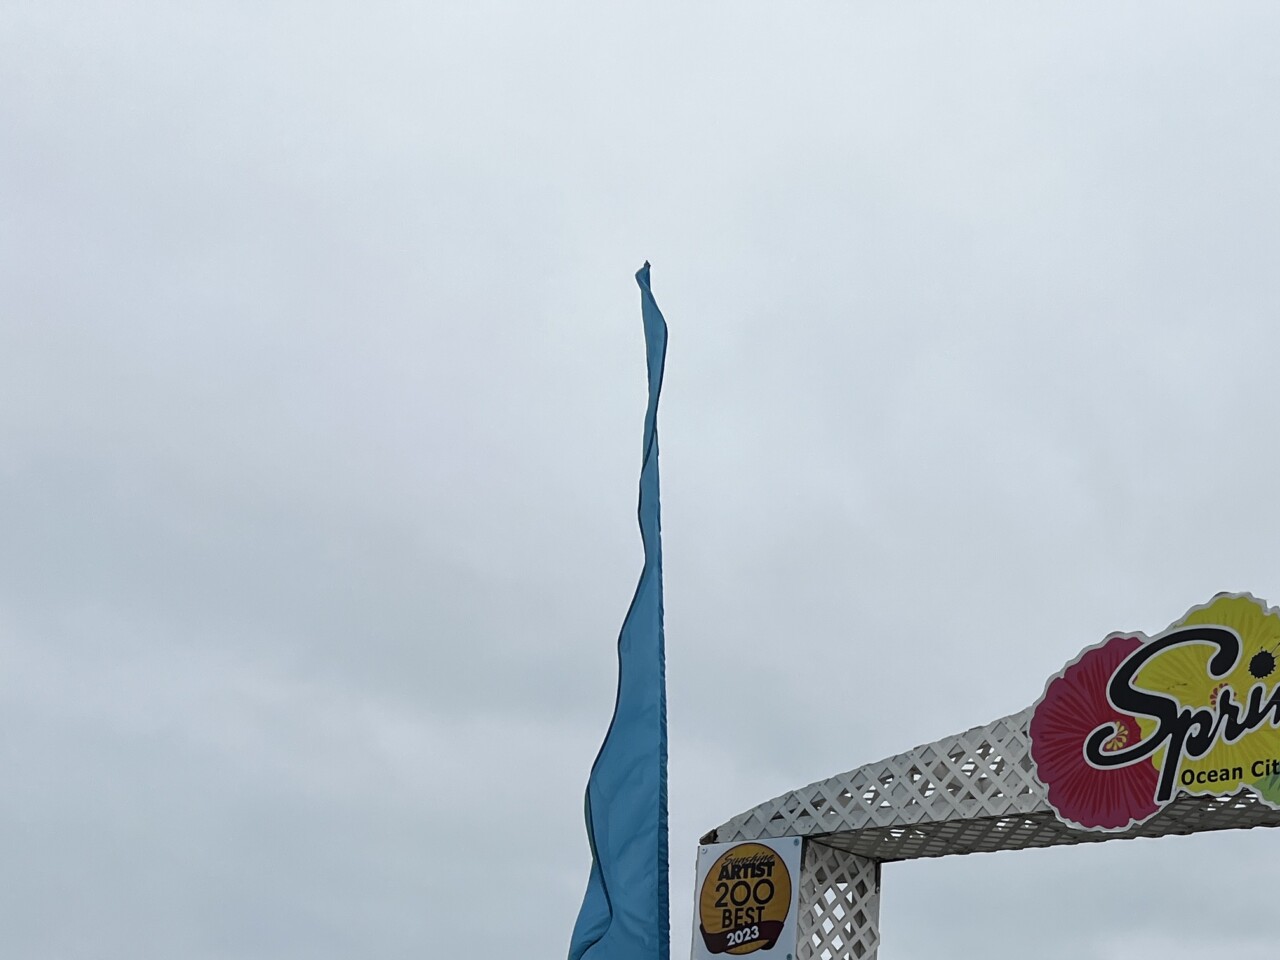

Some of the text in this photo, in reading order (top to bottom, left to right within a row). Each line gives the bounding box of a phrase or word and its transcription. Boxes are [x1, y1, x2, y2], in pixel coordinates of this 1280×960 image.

[1181, 768, 1243, 786] Ocean
[724, 852, 774, 866] Sunshine
[718, 862, 775, 881] ARTIST
[715, 879, 775, 907] 200
[722, 907, 765, 928] BEST
[726, 925, 760, 946] 2023
